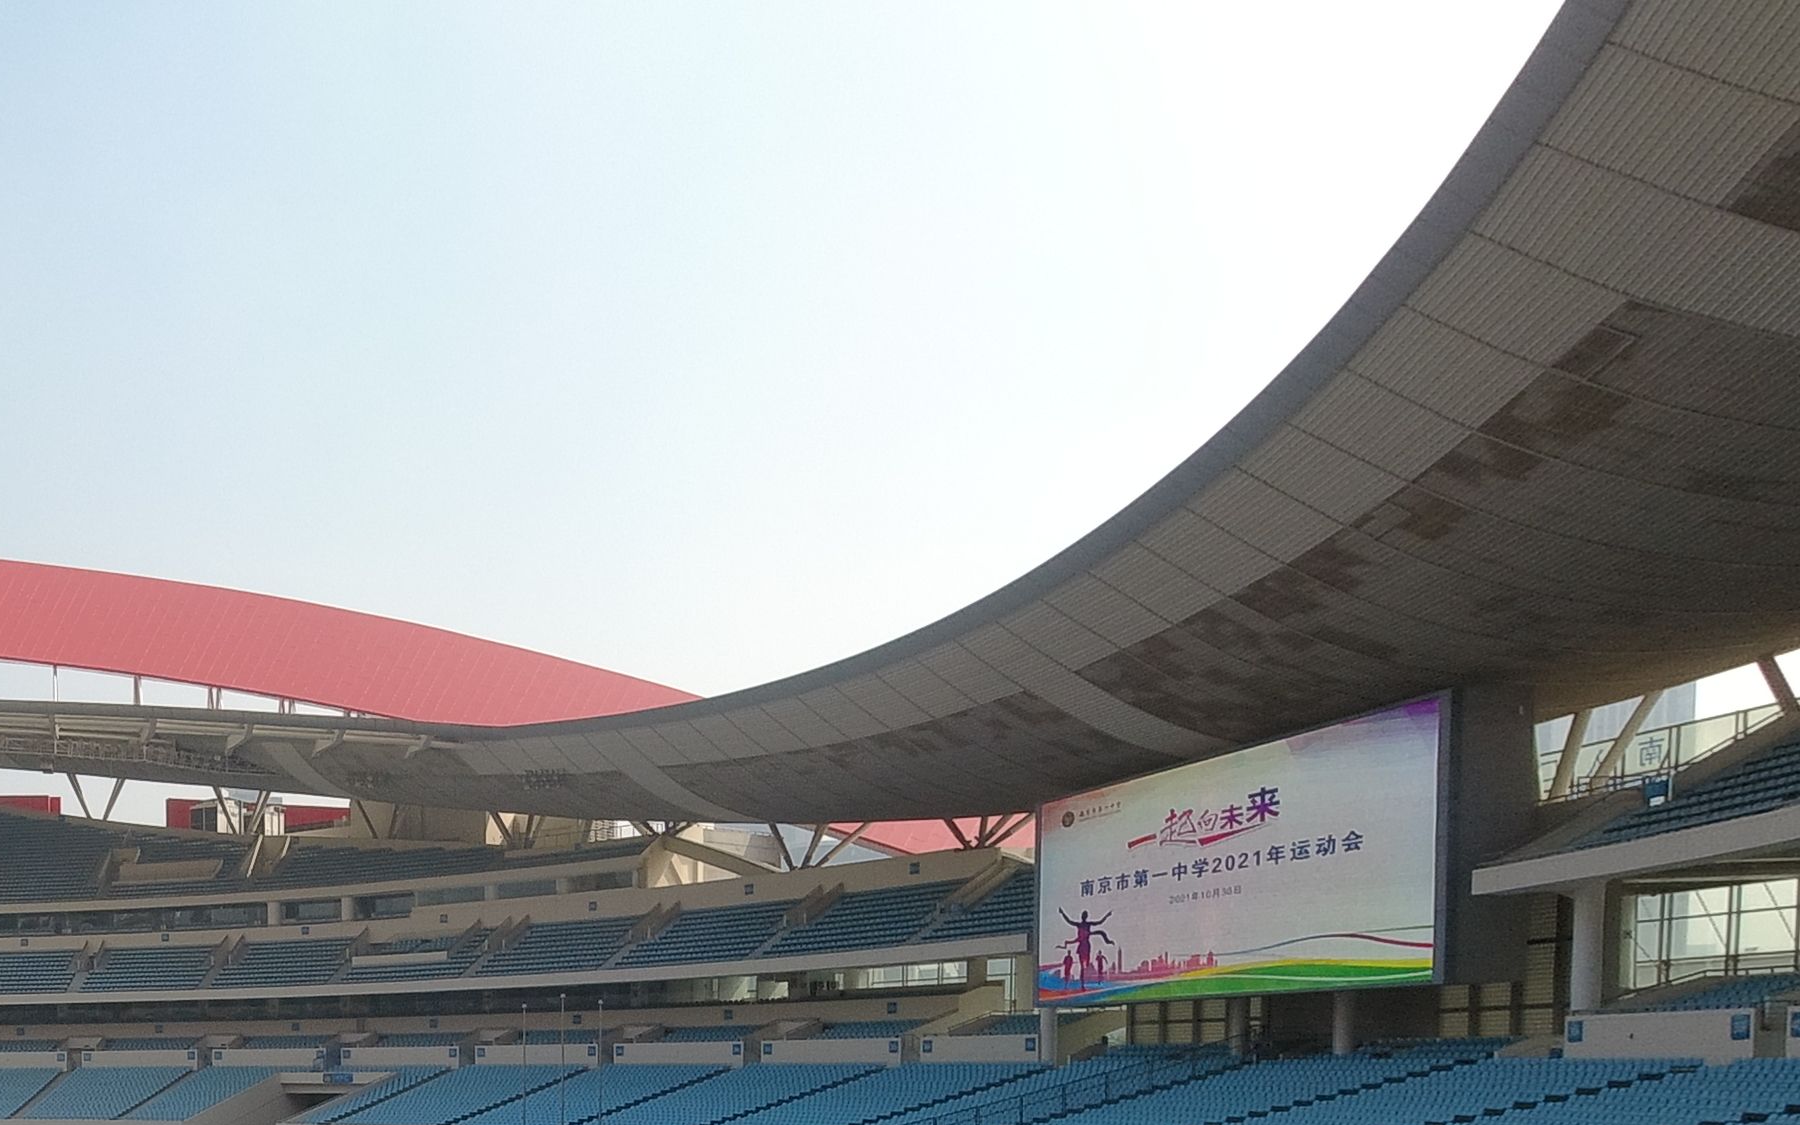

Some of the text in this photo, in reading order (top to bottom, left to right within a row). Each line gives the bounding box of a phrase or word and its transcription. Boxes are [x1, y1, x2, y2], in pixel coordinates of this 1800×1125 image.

[1127, 786, 1281, 850] 一起向未来
[1080, 829, 1365, 897] 南京市第一中学2021年运动会
